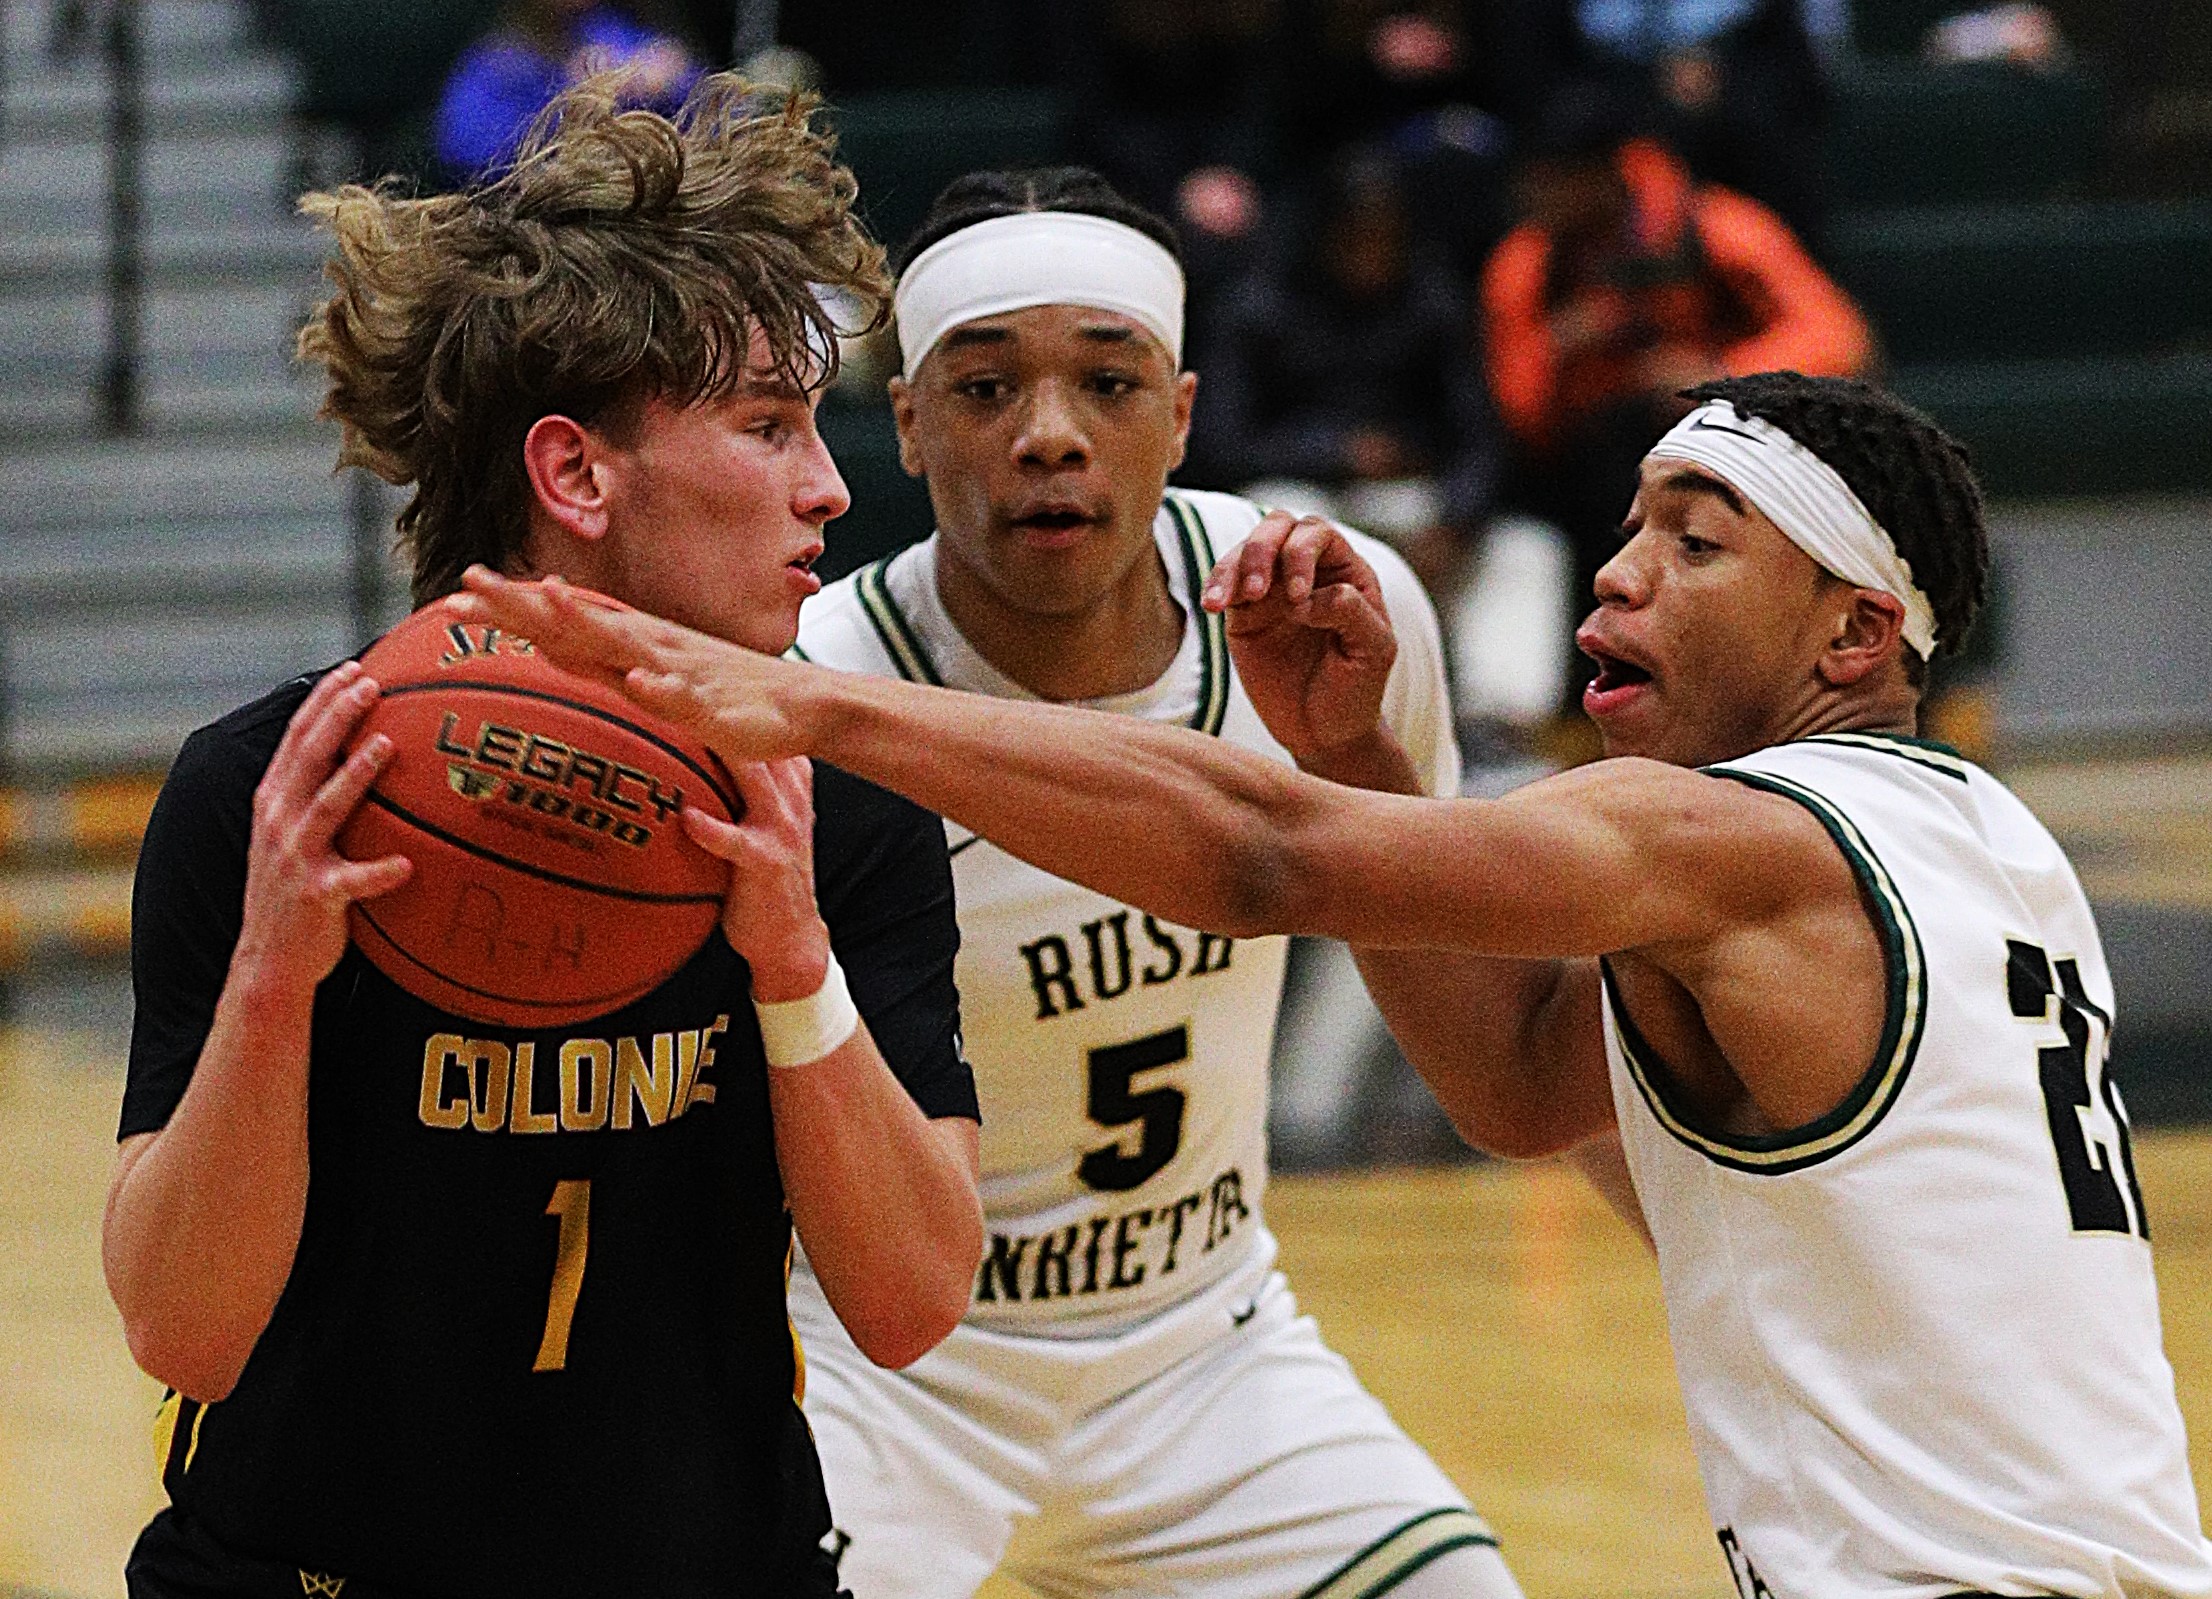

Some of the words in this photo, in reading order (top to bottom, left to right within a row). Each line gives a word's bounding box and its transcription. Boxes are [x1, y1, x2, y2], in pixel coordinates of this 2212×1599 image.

[436, 710, 684, 823] LEGACY
[506, 779, 653, 849] 1000
[418, 1013, 730, 1134] COLONIE
[1077, 1022, 1191, 1191] 5
[531, 1178, 592, 1373] 1
